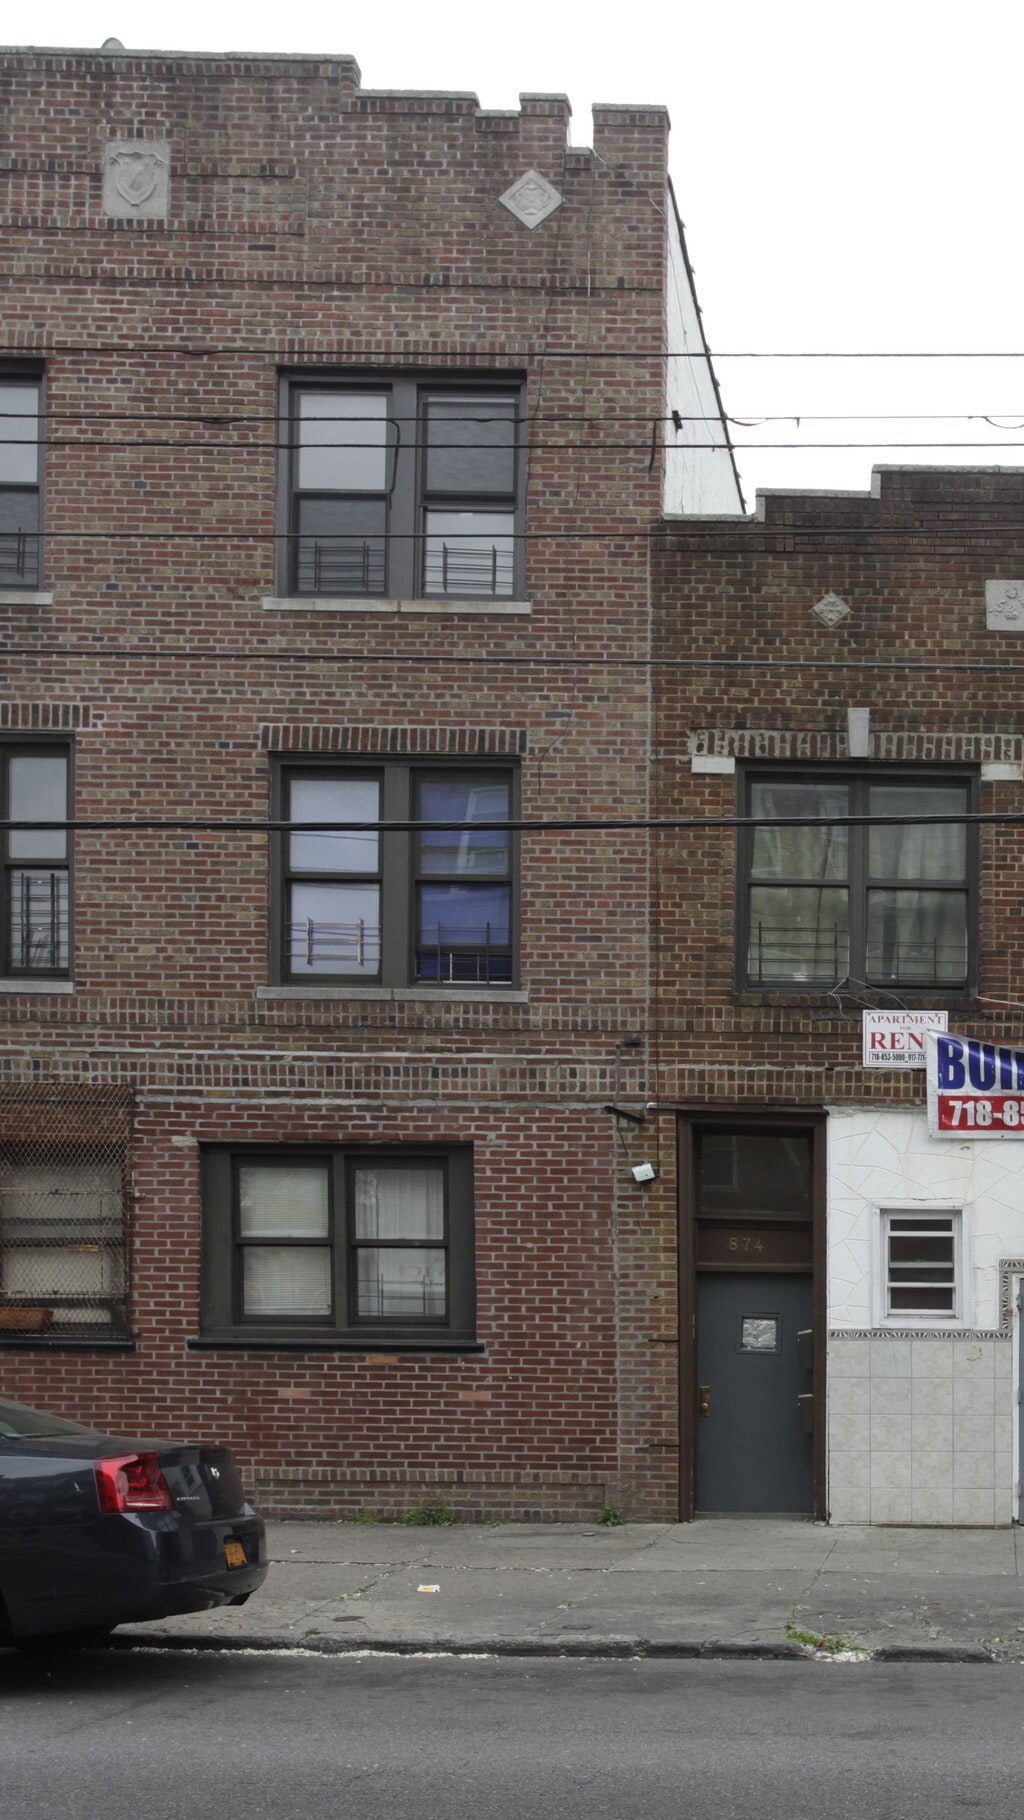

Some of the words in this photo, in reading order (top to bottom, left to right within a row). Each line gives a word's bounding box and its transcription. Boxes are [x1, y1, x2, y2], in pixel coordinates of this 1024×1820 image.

[869, 1015, 943, 1024] APARTMENT
[869, 1032, 925, 1050] REN
[729, 1237, 764, 1252] 874
